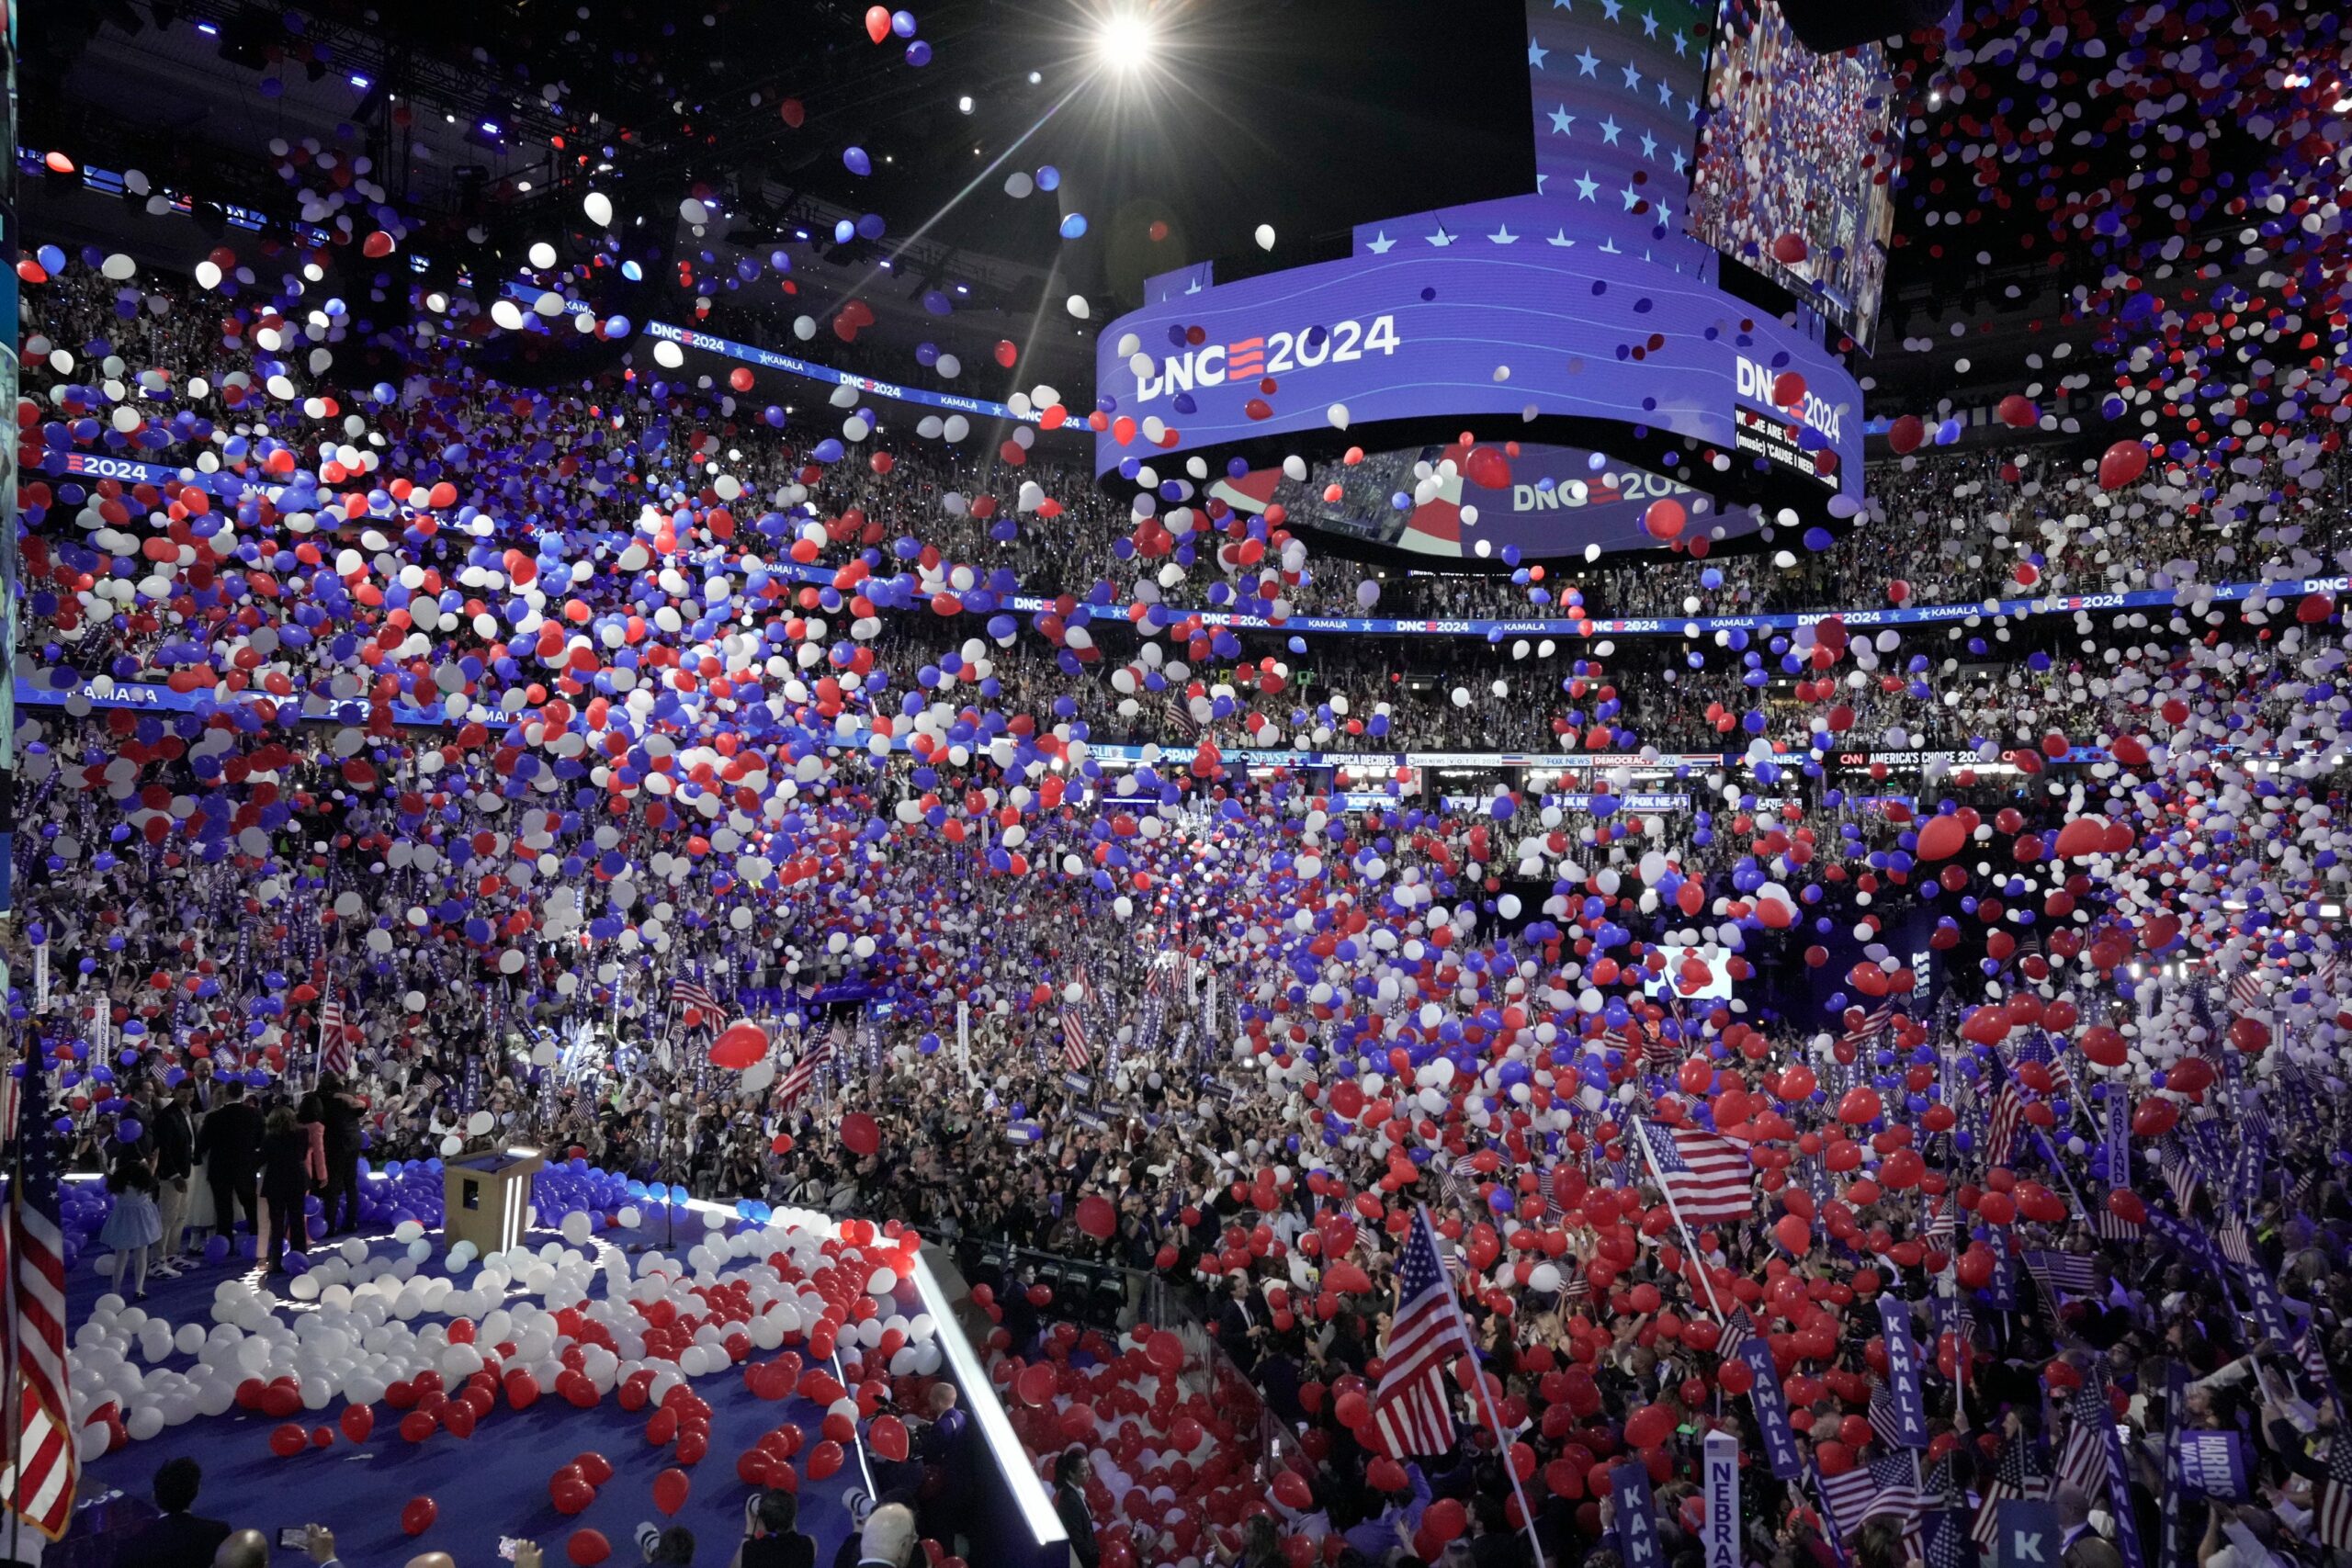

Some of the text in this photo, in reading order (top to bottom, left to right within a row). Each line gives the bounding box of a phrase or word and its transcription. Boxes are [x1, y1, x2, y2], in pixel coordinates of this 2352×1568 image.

[651, 322, 724, 352] DNC 2024
[767, 355, 804, 371] KAMALA
[1137, 315, 1400, 401] DNC 2024
[840, 372, 900, 398] DNC 2024
[941, 396, 978, 411] KAMALA
[1736, 355, 1840, 444] DN 2024
[1767, 423, 1782, 441] ARE
[85, 457, 148, 481] 2024
[1736, 431, 1766, 457] (music)
[1767, 442, 1793, 466] 'CAUSE
[1798, 456, 1815, 475] NEED
[1514, 479, 1588, 511] DNC
[1014, 597, 1043, 610] DNC
[2082, 595, 2124, 608] 2024
[2304, 578, 2347, 592] DNC
[1201, 613, 1270, 628] DNC 2024
[1308, 620, 1348, 629] KAMALA
[1396, 620, 1469, 632] DNC 2024
[1504, 623, 1545, 632] KAMALA
[1591, 620, 1658, 632] NC 2024
[1711, 617, 1754, 627] KAMALA
[1843, 611, 1881, 624] 2024
[1931, 605, 1978, 617] KAMALA
[1322, 754, 1359, 766] AMERICA
[1361, 754, 1396, 766] DECIDES
[1566, 757, 1590, 765] NEWS
[1595, 756, 1651, 765] DEMOCRAC
[1662, 756, 1676, 765] 24
[1840, 753, 1863, 764] CNN
[1869, 751, 1919, 764] AMERICA'S
[239, 926, 247, 964] KAMALA
[428, 947, 446, 983] KAMALA
[869, 1028, 878, 1066] KAMALA
[1108, 1044, 1117, 1083] KAMALA
[467, 1061, 477, 1108] KAMALA
[544, 1076, 552, 1121] KAMALA
[1944, 1057, 1952, 1105] ILLINO
[2227, 1057, 2243, 1115] KAMALA
[2111, 1096, 2126, 1183] MARYLAND
[1628, 1131, 1639, 1188] KAMALA
[2247, 1135, 2260, 1189] AMALA
[1989, 1224, 2008, 1302] KAMALA
[2246, 1272, 2286, 1340] MALA
[1886, 1315, 1919, 1434] KAMALA
[1749, 1352, 1793, 1465] KAMALA
[2181, 1441, 2203, 1487] WALZ
[2198, 1436, 2236, 1497] HARRIS
[1712, 1462, 1732, 1567] NEBRA
[2103, 1429, 2137, 1567] KAMAL
[1624, 1484, 1654, 1567] KAM
